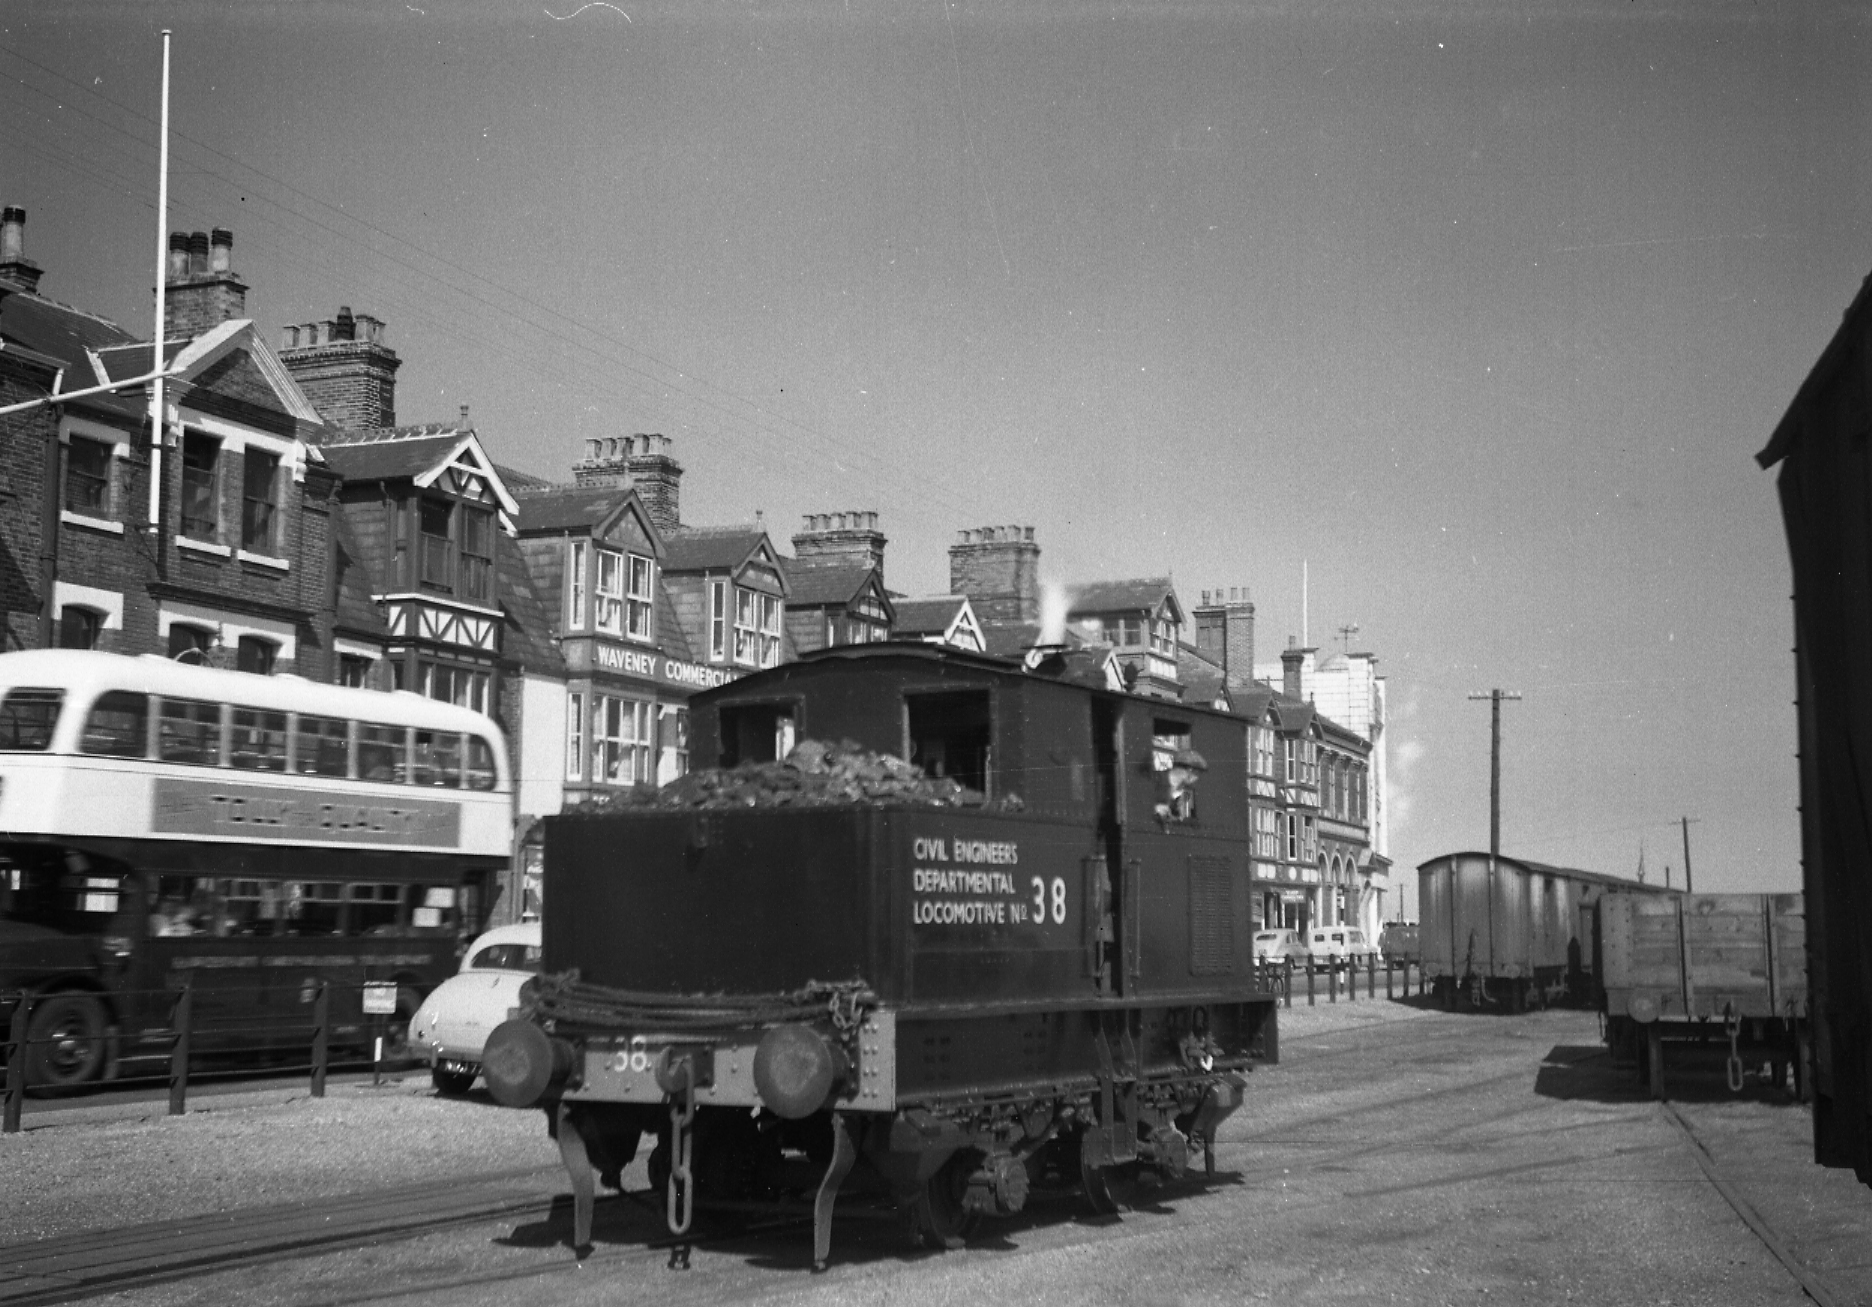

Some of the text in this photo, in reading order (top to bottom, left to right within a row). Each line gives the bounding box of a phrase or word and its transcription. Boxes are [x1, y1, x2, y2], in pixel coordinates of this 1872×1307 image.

[598, 646, 656, 675] WAVENEY
[914, 837, 1018, 864] CIVIL ENGINEERS
[914, 868, 1016, 893] DEPARTMENTAL
[914, 901, 1005, 924] LOCOMOTIVE
[1031, 876, 1066, 924] 38
[614, 1035, 647, 1072] 38
